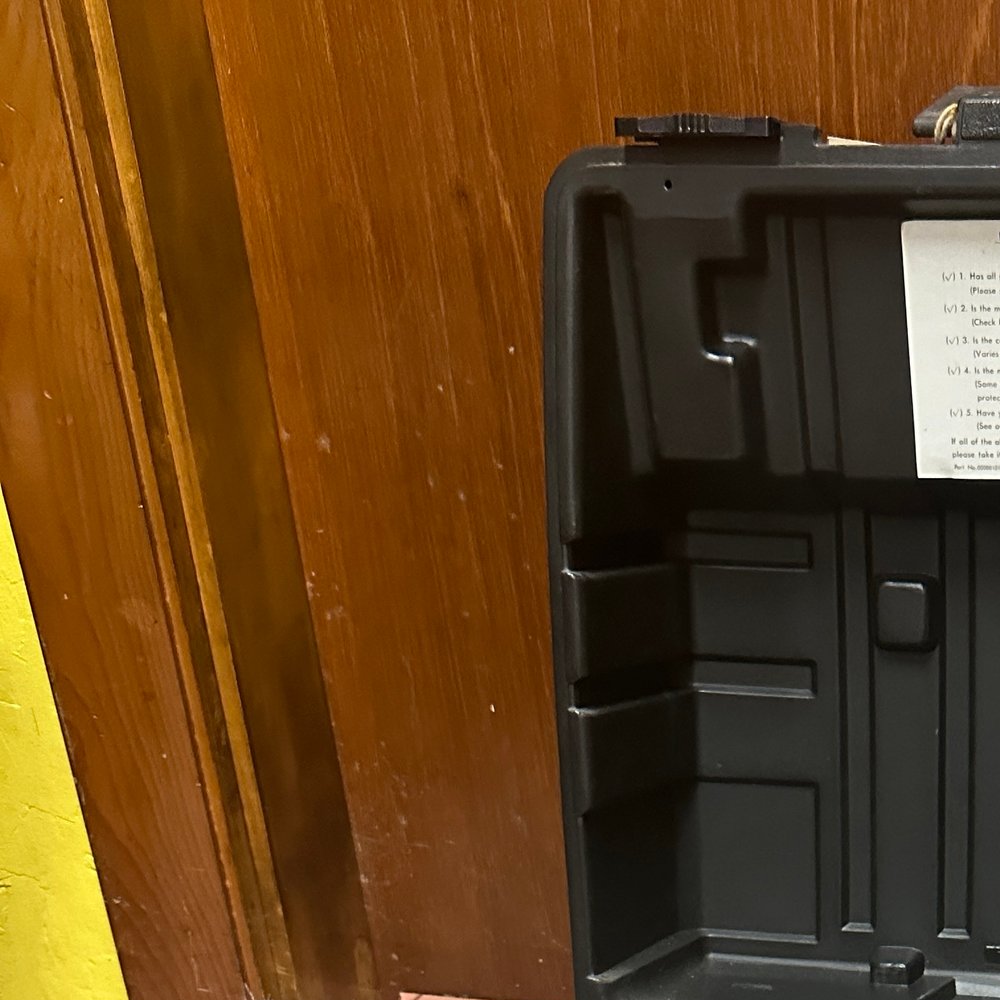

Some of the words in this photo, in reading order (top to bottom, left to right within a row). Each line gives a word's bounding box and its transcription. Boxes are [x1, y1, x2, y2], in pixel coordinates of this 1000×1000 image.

[970, 272, 984, 280] Has
[987, 272, 996, 280] all
[952, 451, 975, 459] please
